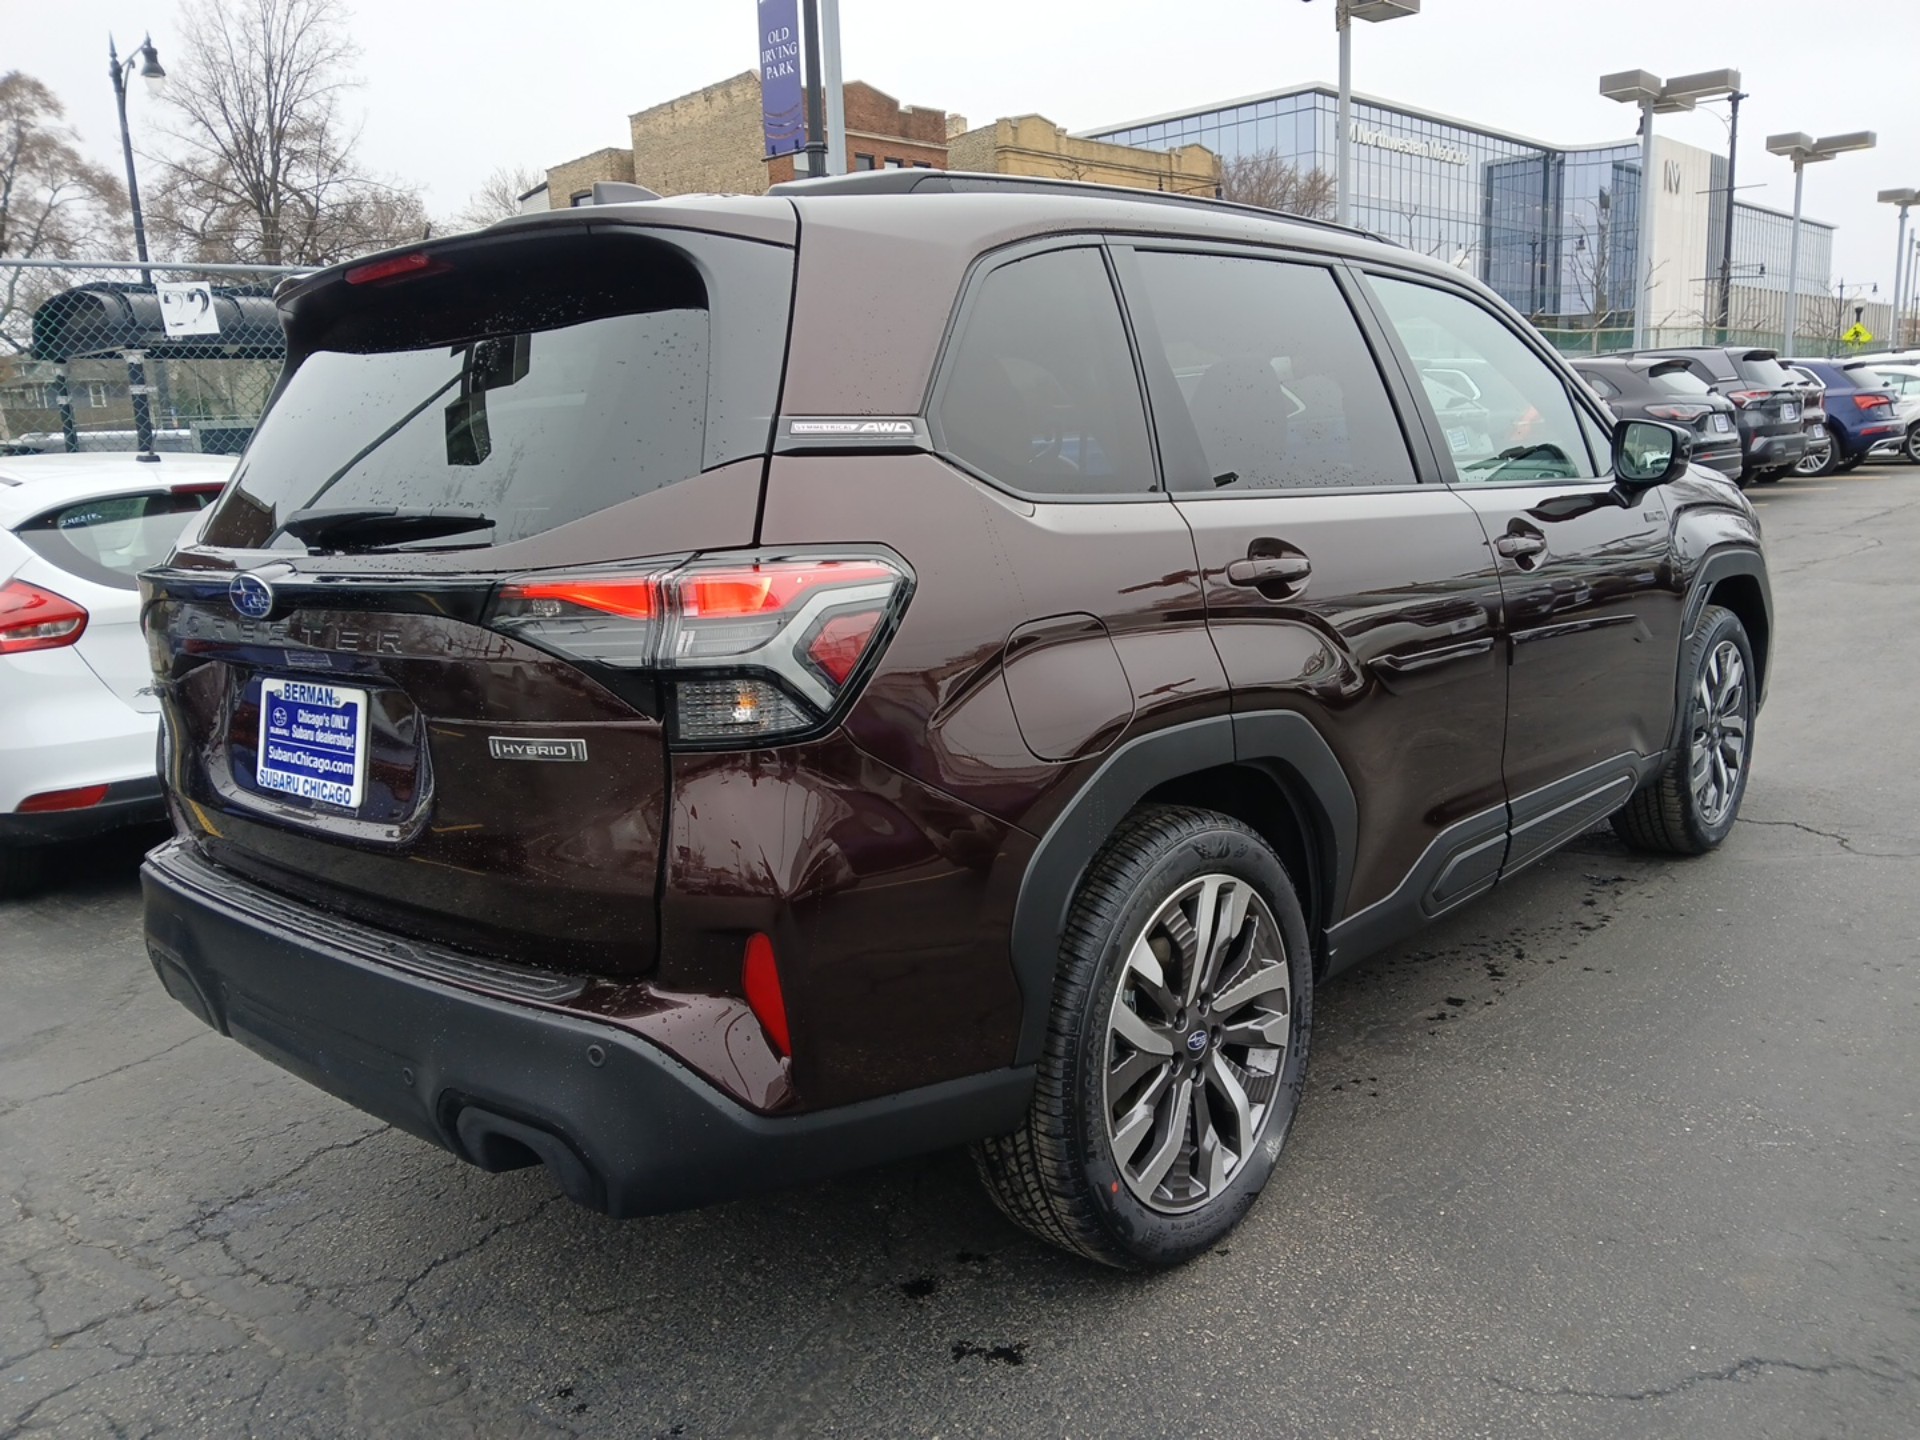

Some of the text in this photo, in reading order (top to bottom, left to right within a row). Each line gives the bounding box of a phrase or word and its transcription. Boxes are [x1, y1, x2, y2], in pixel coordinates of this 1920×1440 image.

[768, 27, 789, 44] OLD
[761, 41, 798, 64] IRVING
[766, 60, 795, 80] PARK
[1356, 122, 1429, 158] Northwestern
[859, 422, 912, 432] AWD
[283, 682, 333, 706] BERMAN
[297, 708, 350, 731] Chicago's ONLY
[291, 723, 355, 751] Subaru dealership!
[268, 745, 354, 775] SubaruChicago.com
[502, 744, 568, 756] HYBRID
[259, 768, 352, 805] SUBARU CHICAGO
